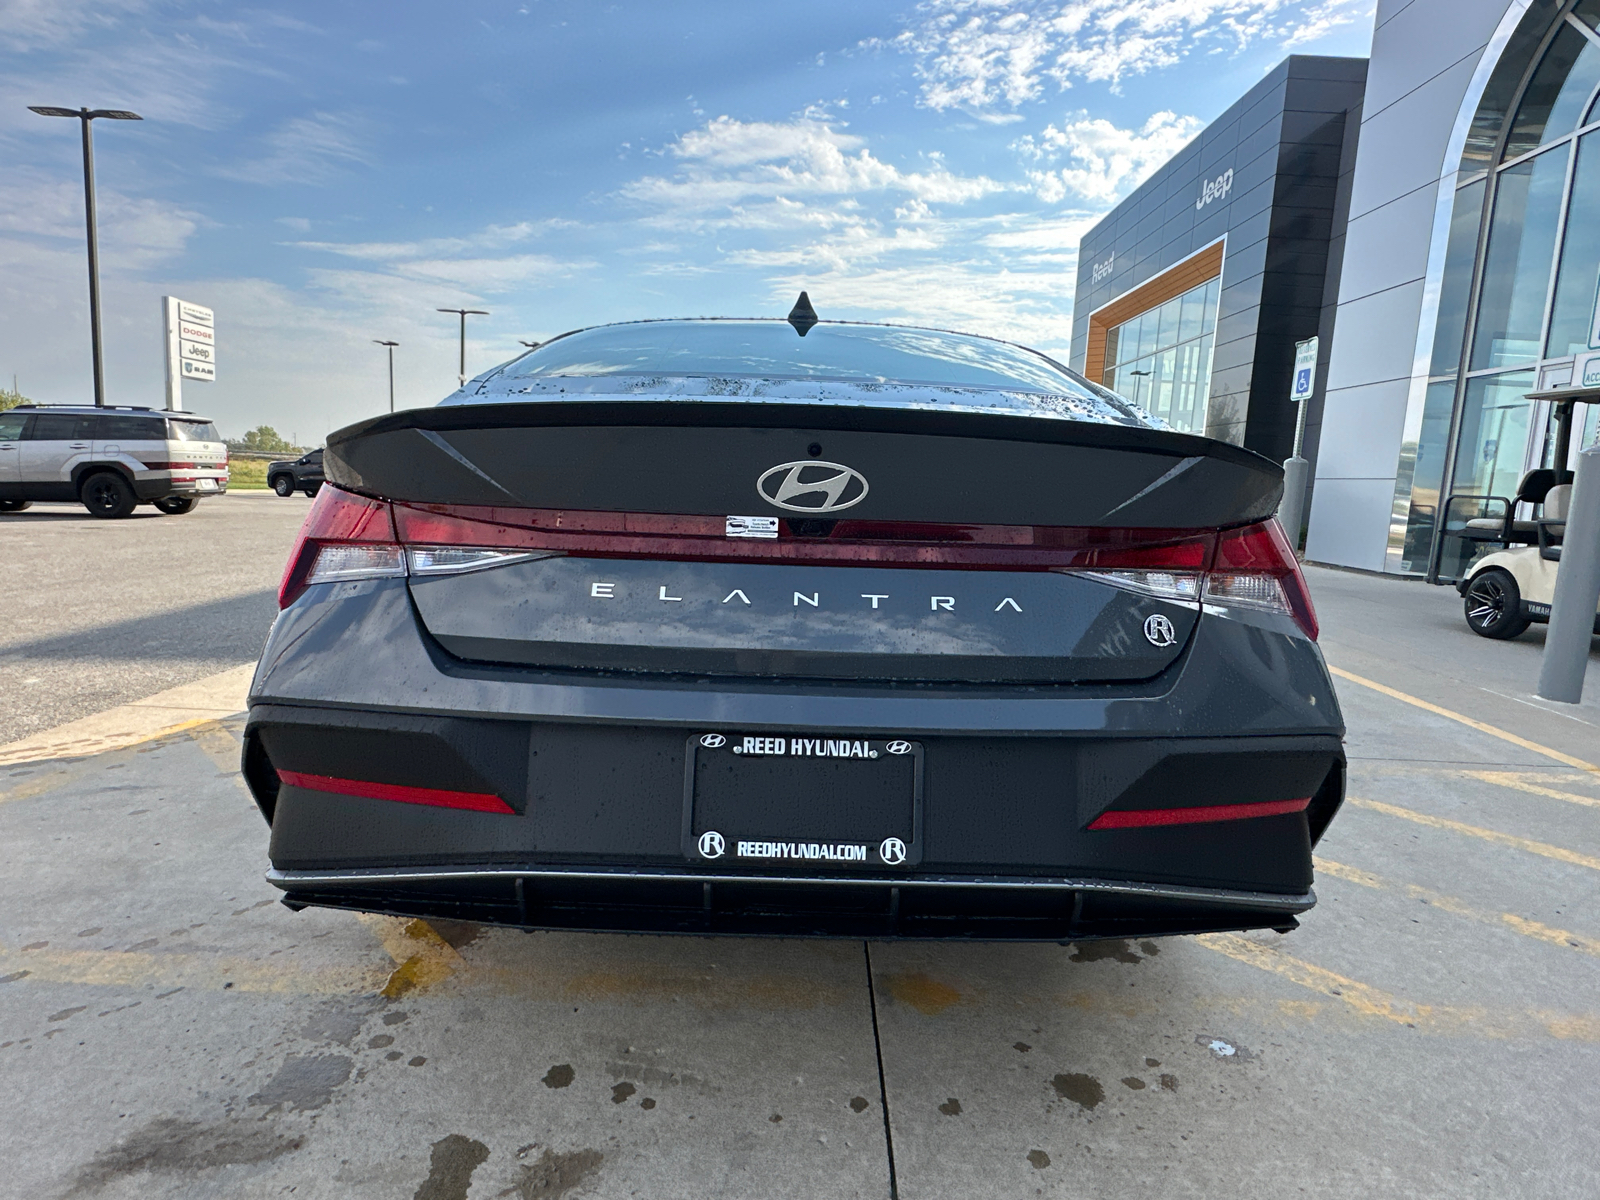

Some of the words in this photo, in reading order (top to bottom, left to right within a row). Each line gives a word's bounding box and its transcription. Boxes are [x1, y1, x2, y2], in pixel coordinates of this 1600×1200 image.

[1196, 168, 1234, 210] Jeep
[1091, 251, 1115, 285] Reed
[183, 327, 213, 339] DODGE
[189, 344, 210, 360] Jeep
[193, 366, 214, 375] RAM
[1585, 372, 1600, 383] ACC
[590, 582, 1025, 613] ELANTRA
[1528, 604, 1550, 616] YAMAH
[743, 736, 786, 755] REED
[791, 738, 869, 758] HYUNDAI
[737, 841, 867, 861] REEDHYUNDAI.COM
